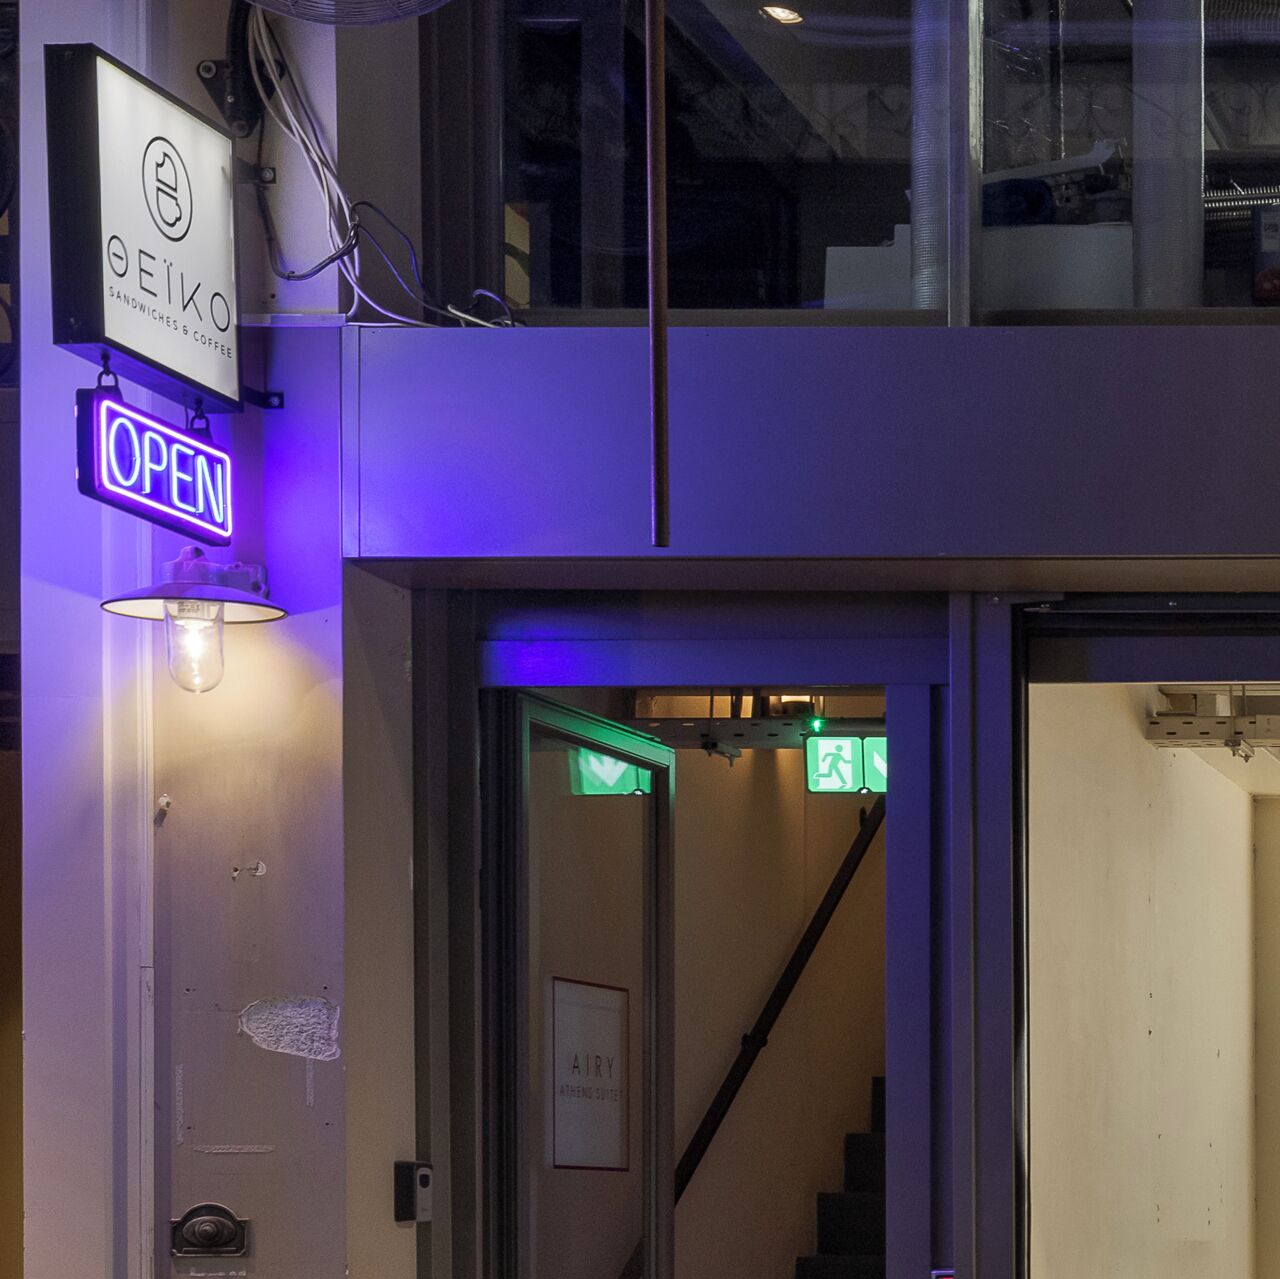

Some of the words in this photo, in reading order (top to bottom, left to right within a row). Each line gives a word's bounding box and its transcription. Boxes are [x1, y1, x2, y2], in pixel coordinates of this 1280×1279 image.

[109, 286, 178, 331] SANDWICHES
[183, 325, 189, 335] &
[193, 331, 232, 359] COFFEE
[108, 416, 224, 523] OPEN
[572, 1053, 614, 1079] AIRY
